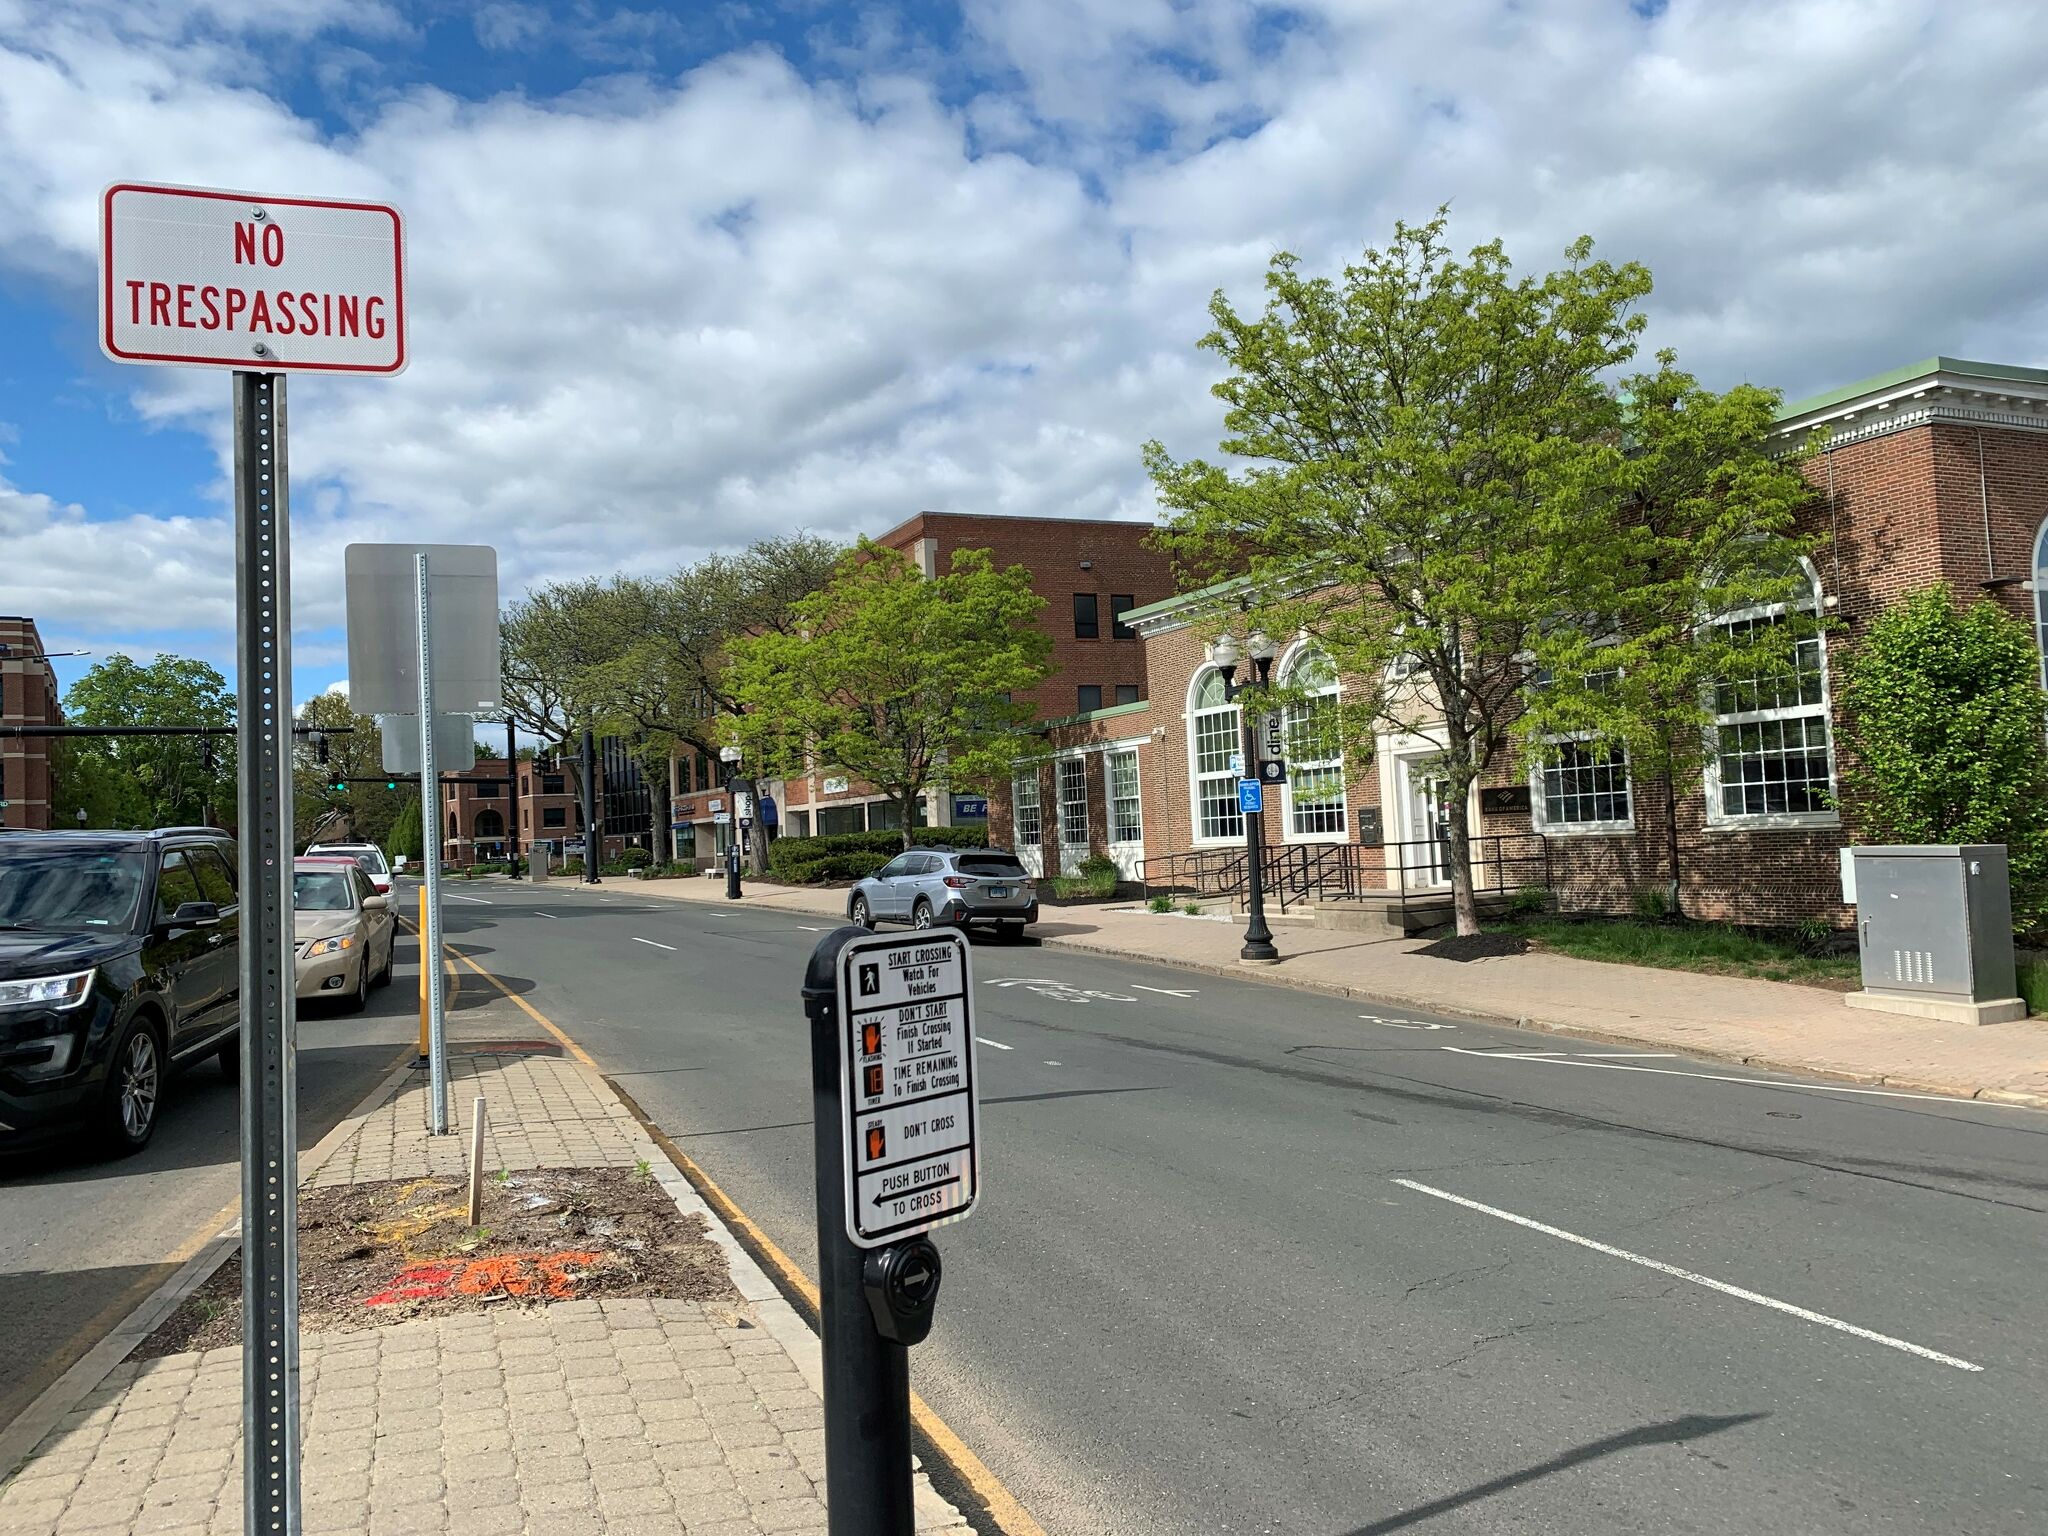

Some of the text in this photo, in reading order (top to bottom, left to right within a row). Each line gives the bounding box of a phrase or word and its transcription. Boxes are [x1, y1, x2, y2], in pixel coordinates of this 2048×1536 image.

[234, 221, 284, 267] NO
[126, 280, 385, 339] TRESPASSING
[1267, 718, 1281, 755] dine
[744, 795, 752, 816] shop
[963, 804, 977, 813] BE
[888, 946, 952, 966] START CROSSING
[903, 967, 939, 982] Watch For
[908, 982, 936, 996] Vehicles
[899, 1002, 947, 1022] DON'T START
[897, 1020, 951, 1040] Finish Crossing
[907, 1036, 942, 1054] If Started
[893, 1055, 958, 1081] TIME REMAINING
[893, 1073, 960, 1097] To Finish Crossing
[904, 1115, 955, 1139] DON'T CROSS
[882, 1162, 950, 1192] PUSH BUTTON
[893, 1191, 942, 1216] TO CROSS
